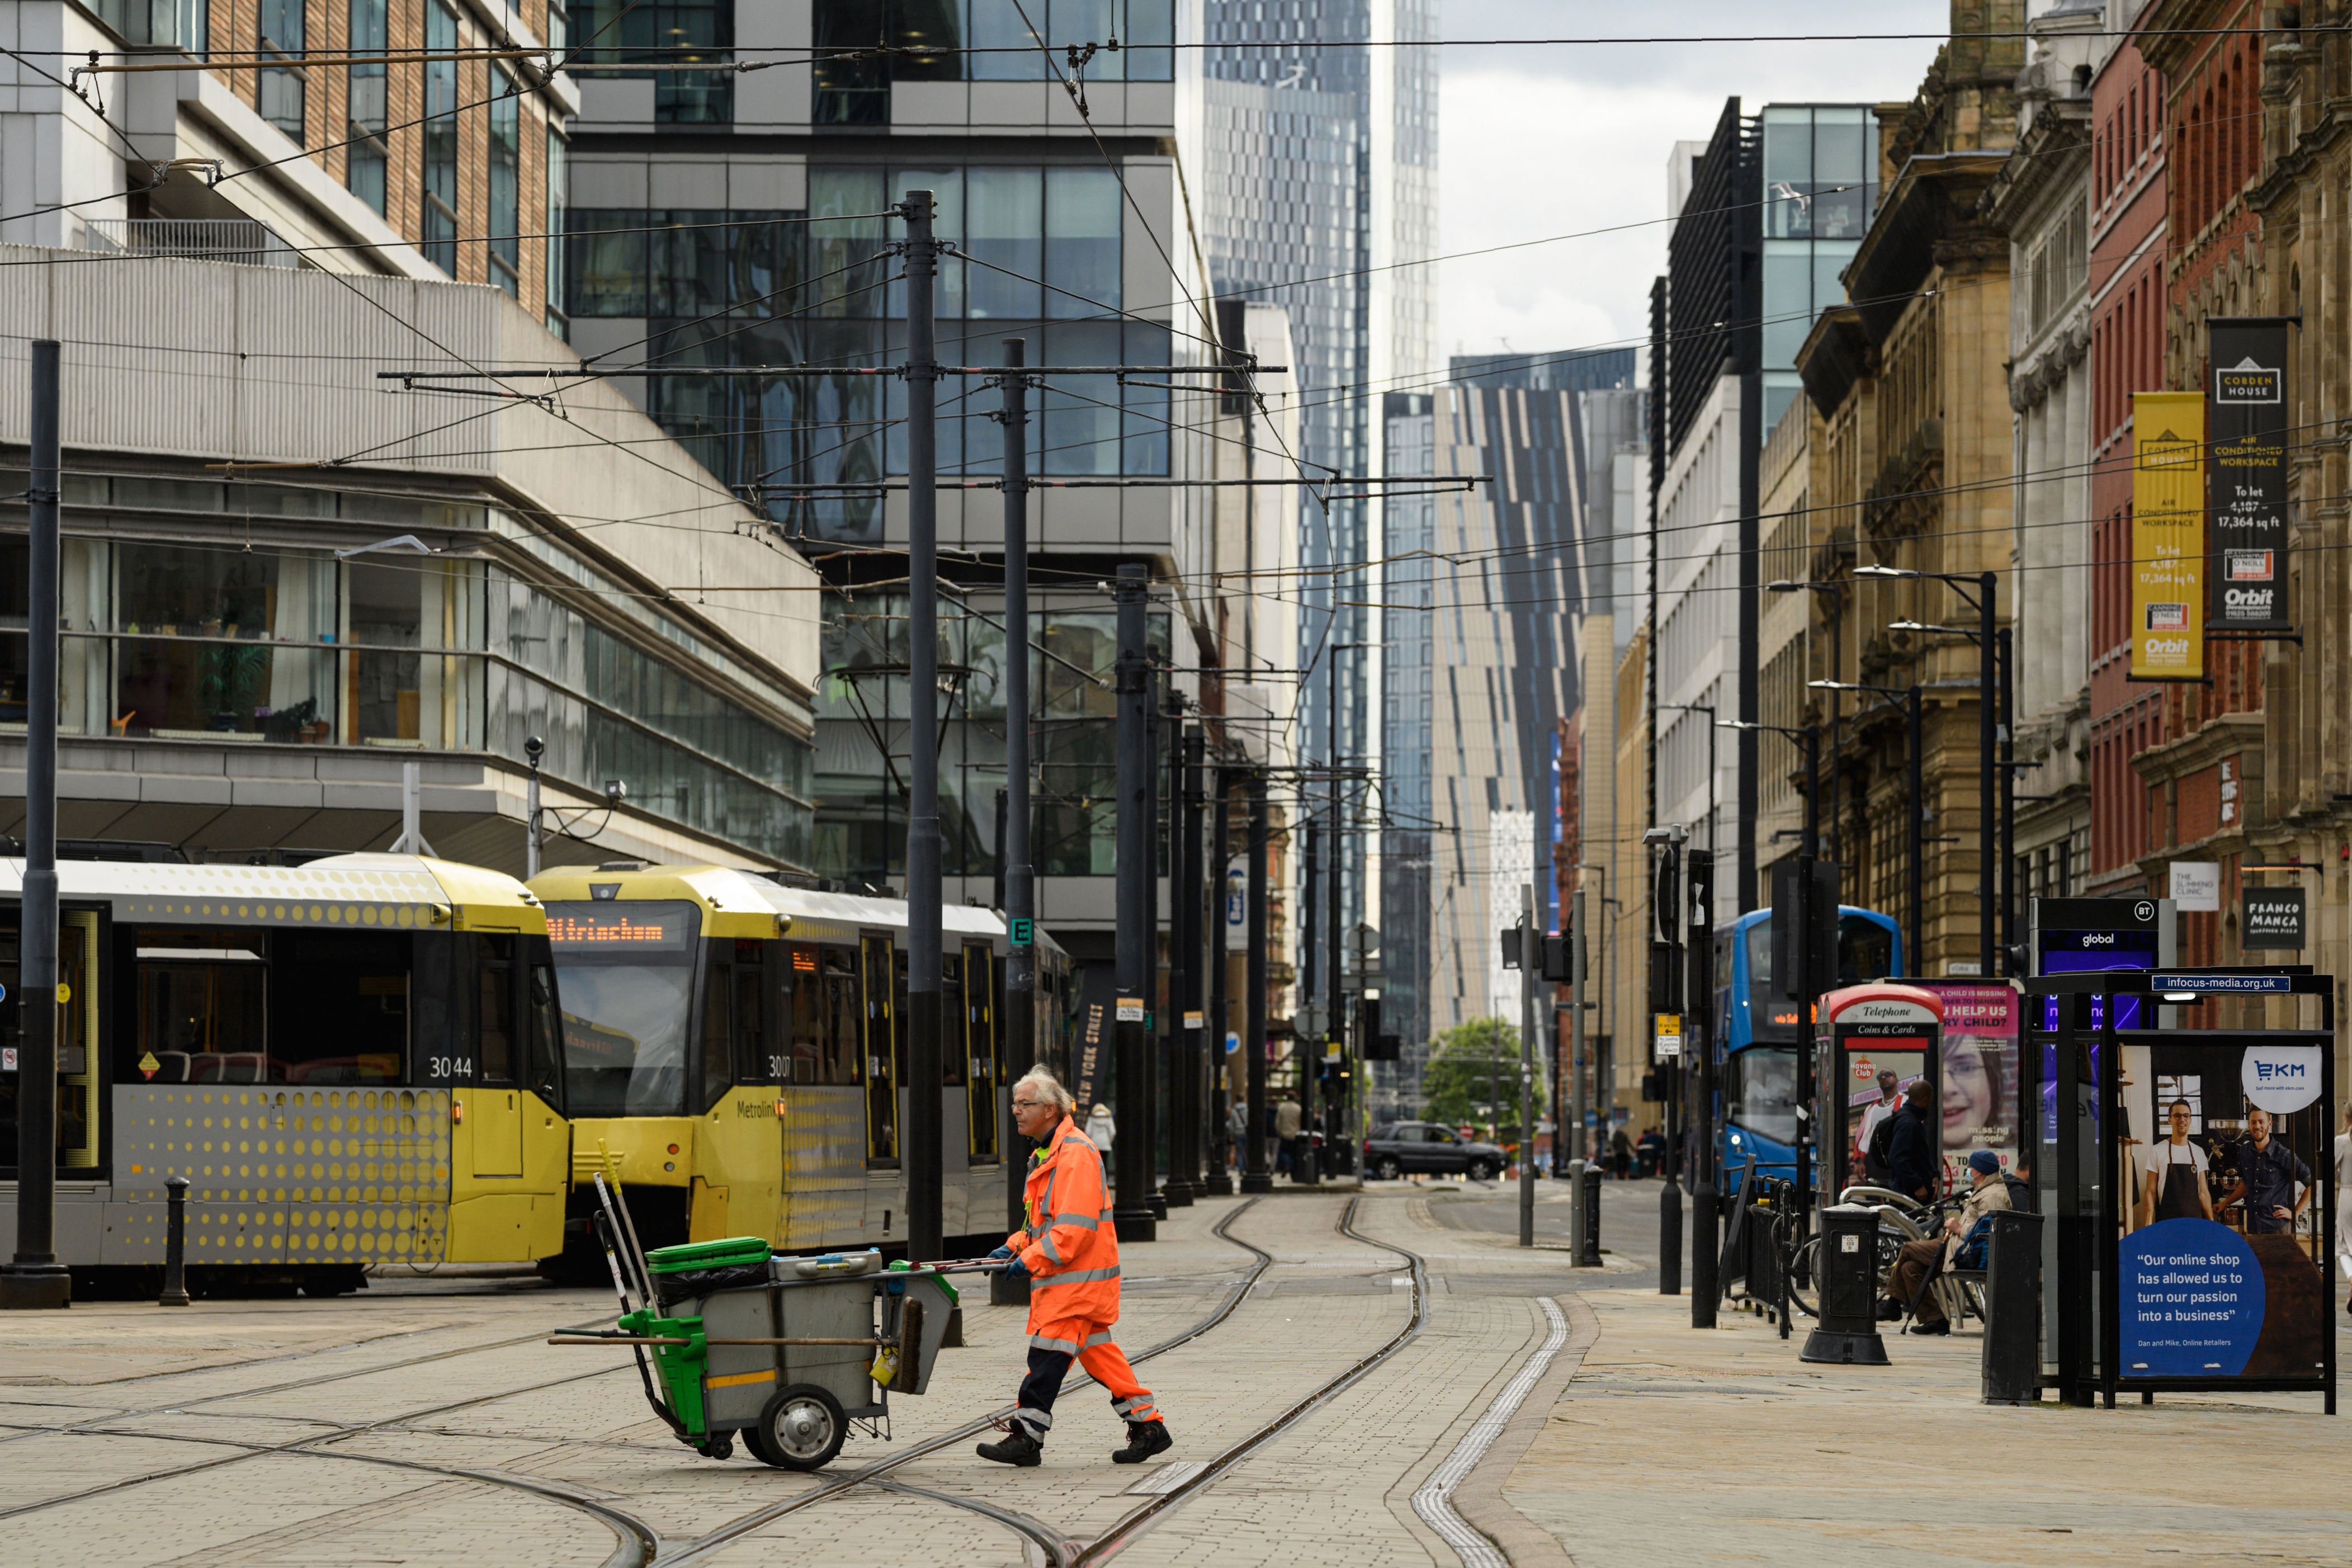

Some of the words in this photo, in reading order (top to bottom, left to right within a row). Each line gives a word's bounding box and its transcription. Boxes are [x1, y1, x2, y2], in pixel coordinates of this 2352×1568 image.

[2224, 377, 2272, 385] COBDEN
[2229, 387, 2268, 396] HOUSE
[2214, 446, 2283, 455] CONDITIONED
[2150, 456, 2185, 464] HOUSE
[2219, 457, 2278, 466] WORKSPACE
[2235, 485, 2247, 497] To
[2249, 485, 2263, 497] let
[2218, 516, 2254, 529] 17,364
[2256, 519, 2268, 531] sq
[2270, 516, 2280, 527] ft
[2156, 546, 2166, 555] To
[2169, 546, 2180, 555] let
[2140, 574, 2172, 584] 17,364
[2175, 577, 2184, 585] sq
[2187, 573, 2195, 583] ft
[2225, 588, 2274, 605] Orbit
[2145, 639, 2189, 653] Orbit
[2138, 907, 2150, 915] BT
[2249, 903, 2299, 914] FRANCO
[2251, 915, 2298, 927] MANCA
[546, 917, 662, 941] Altrincham
[1015, 922, 1029, 941] E
[2082, 933, 2114, 947] global
[2167, 977, 2275, 990] infocus-media.org.uk
[1863, 1007, 1911, 1018] Telephone
[1952, 1006, 1986, 1016] HELP
[1989, 1006, 2007, 1016] US
[1085, 1004, 1103, 1043] STREET
[1964, 1018, 2006, 1027] CHILD?
[1858, 1025, 1881, 1033] Coins
[1882, 1025, 1890, 1033] &
[1891, 1025, 1916, 1033] Cards
[429, 1057, 472, 1078] 3044
[769, 1055, 790, 1077] 3007
[1081, 1047, 1097, 1076] YORK
[2254, 1060, 2304, 1081] EKM
[738, 1100, 776, 1118] Metrolink
[1972, 1135, 2005, 1144] people
[2137, 1254, 2166, 1265] “Our
[2169, 1254, 2207, 1265] online
[2210, 1253, 2240, 1267] shop
[2138, 1273, 2159, 1284] has
[2162, 1272, 2209, 1284] allowed
[2213, 1274, 2227, 1283] us
[2230, 1273, 2242, 1283] to
[2138, 1292, 2163, 1303] turn
[2166, 1294, 2187, 1302] our
[2190, 1291, 2237, 1305] passion
[2138, 1310, 2161, 1321] into
[2165, 1312, 2172, 1321] a
[2175, 1310, 2236, 1321] business”
